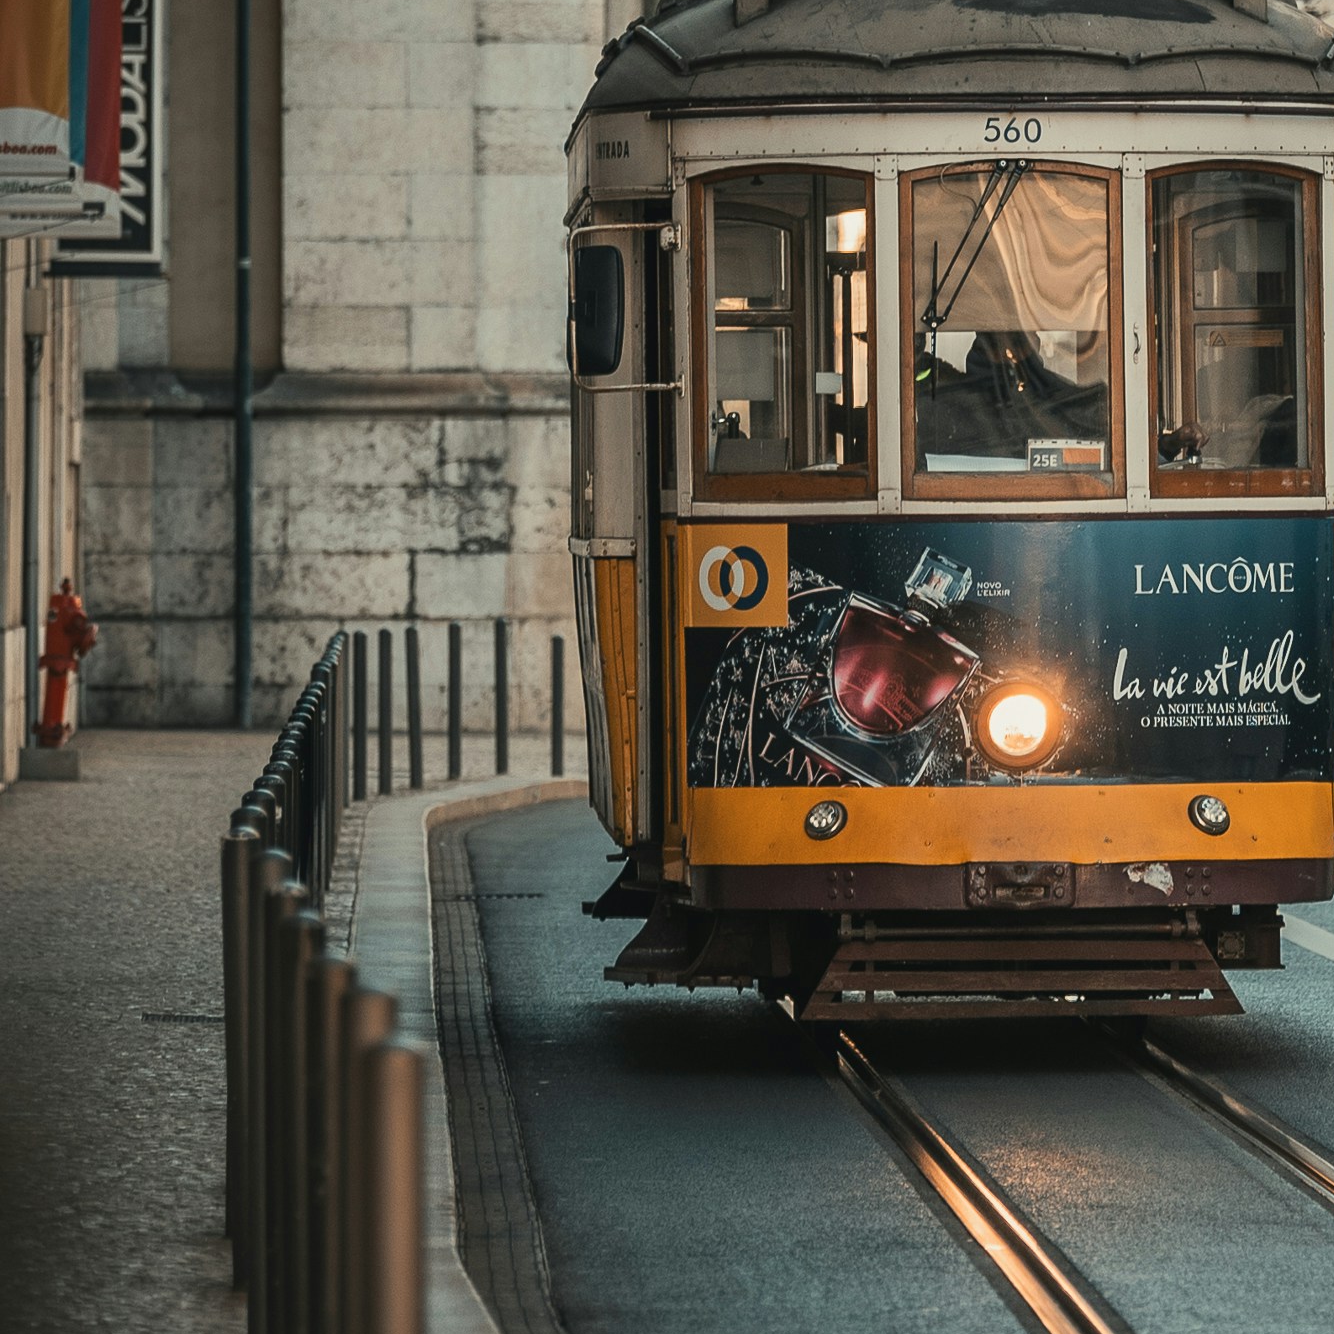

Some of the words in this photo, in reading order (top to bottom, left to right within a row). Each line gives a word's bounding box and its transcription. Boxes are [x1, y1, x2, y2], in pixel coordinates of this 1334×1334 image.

[983, 117, 1042, 143] 560
[1032, 454, 1058, 467] 25E
[1134, 556, 1295, 595] LANCÔME
[976, 581, 1002, 589] NOVO
[976, 589, 1011, 597] L'ELIXIR
[1113, 647, 1146, 701] La
[1152, 666, 1189, 699] vie
[1192, 646, 1239, 696] est
[1238, 629, 1322, 705] belle
[1156, 703, 1166, 716] A
[1168, 703, 1205, 715] NOITE
[1207, 702, 1235, 714] MAIS
[1140, 717, 1151, 728] O
[1153, 716, 1214, 727] PRESENTE
[1216, 715, 1244, 727] MAIS
[1246, 714, 1291, 726] ESPECIAL
